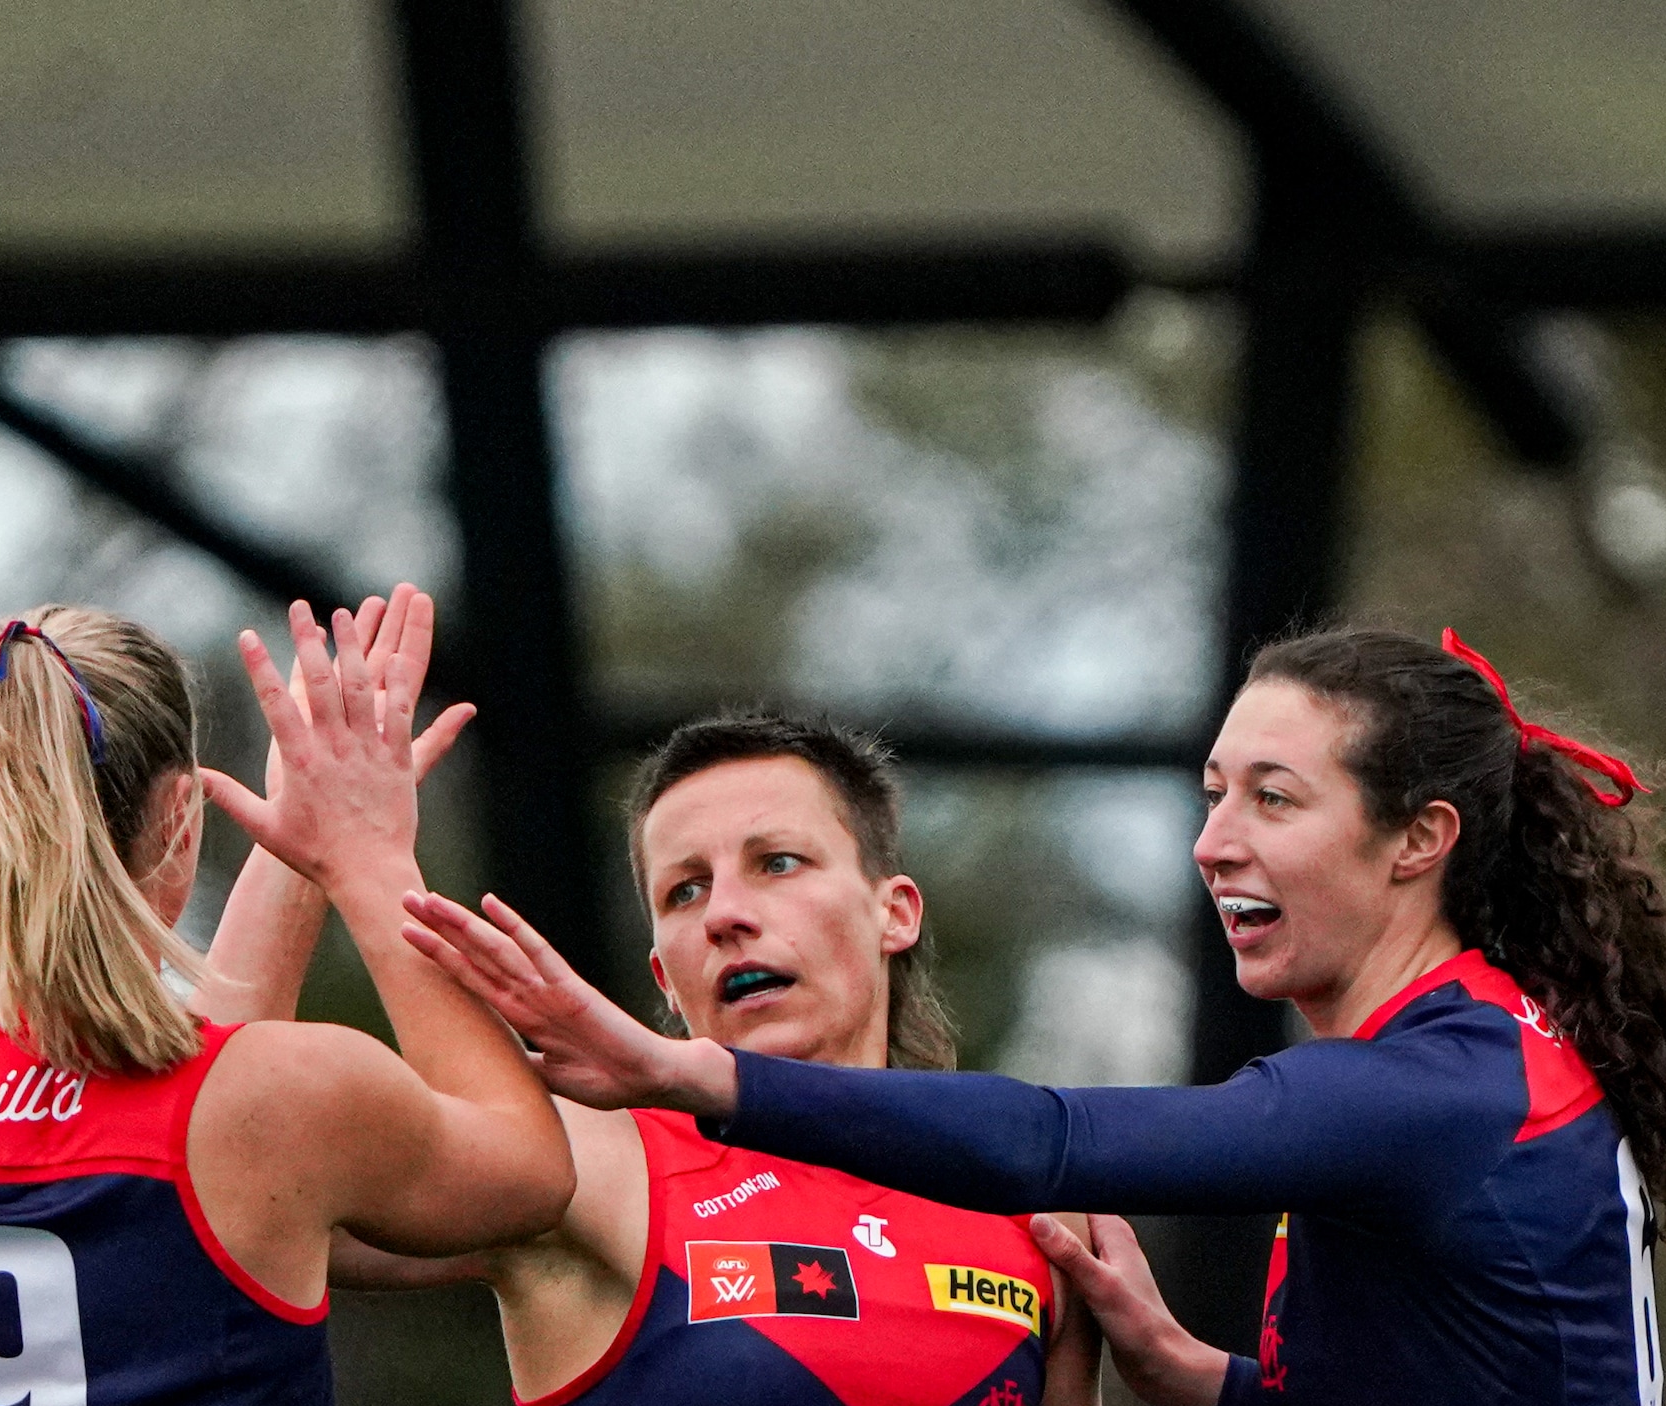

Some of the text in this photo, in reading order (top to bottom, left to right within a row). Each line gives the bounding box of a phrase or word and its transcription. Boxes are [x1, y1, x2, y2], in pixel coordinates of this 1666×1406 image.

[693, 1171, 781, 1218] COTTON:ON
[716, 1259, 747, 1270] AFL
[949, 1268, 1034, 1317] Hertz
